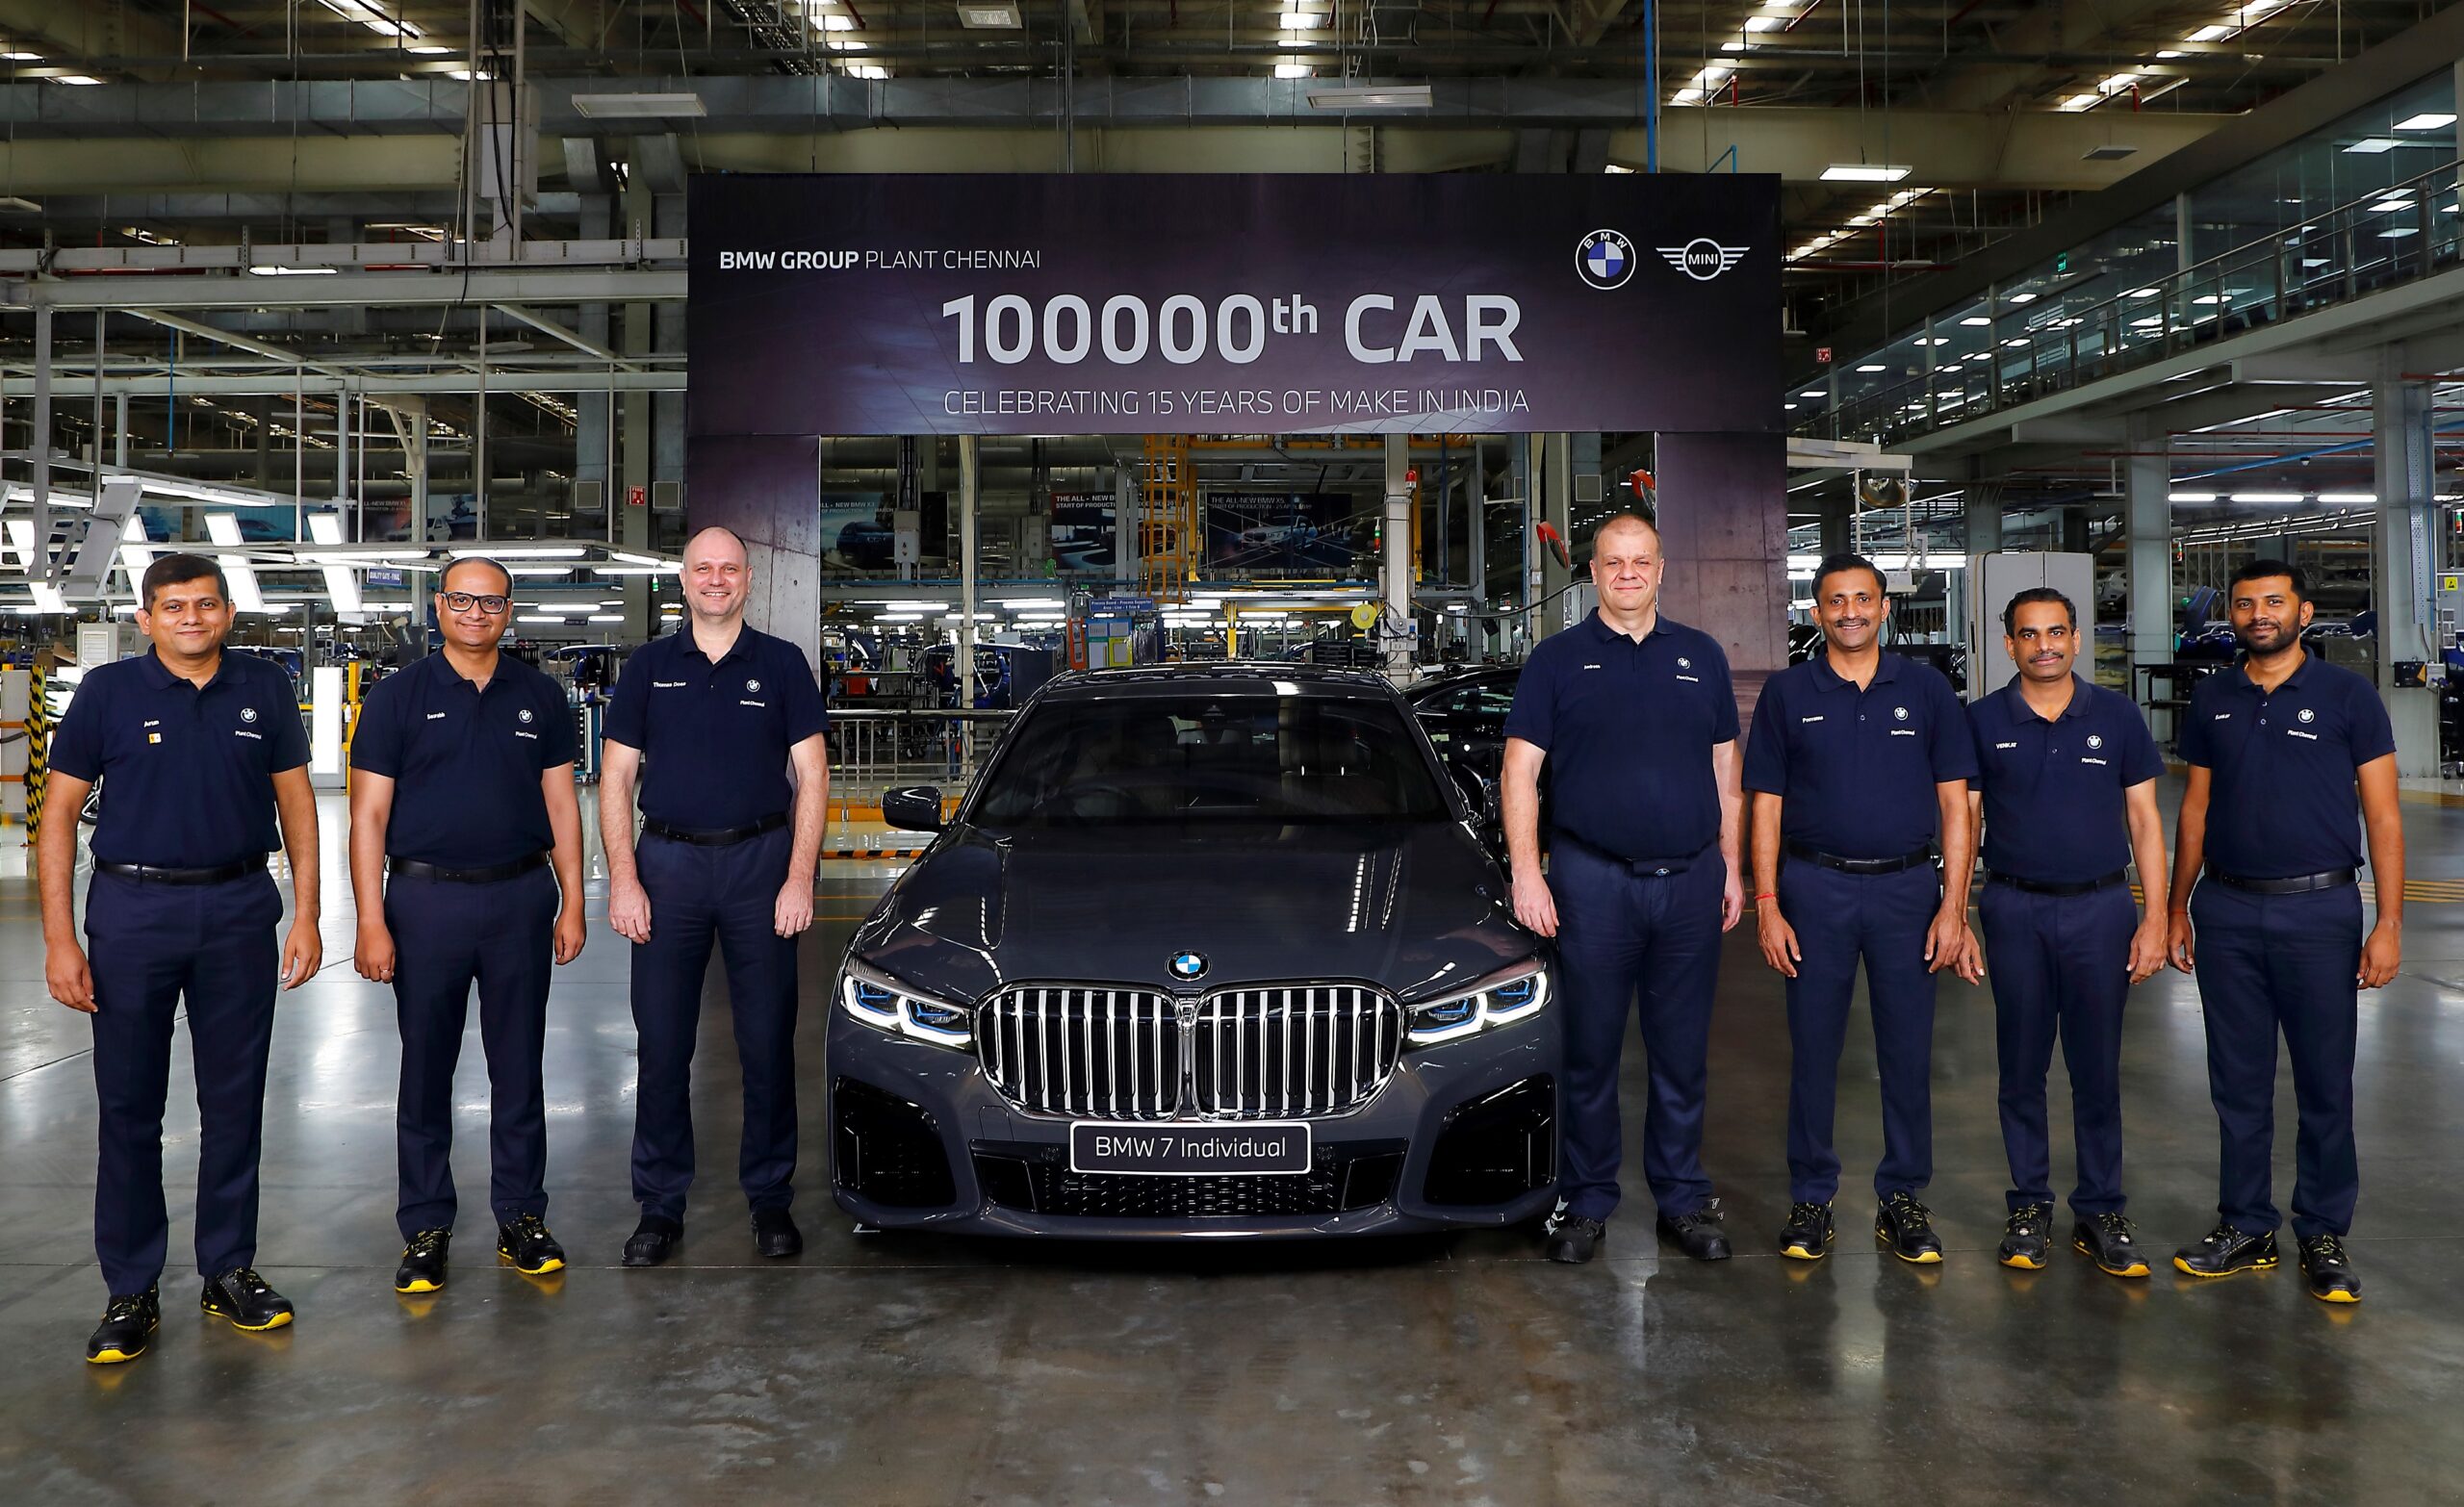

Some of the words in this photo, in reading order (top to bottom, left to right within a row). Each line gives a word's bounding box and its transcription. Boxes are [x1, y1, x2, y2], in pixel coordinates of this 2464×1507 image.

[1583, 232, 1629, 250] BMW
[720, 251, 776, 269] BMW
[781, 250, 860, 269] GROUP
[865, 250, 938, 269] PLANT
[943, 249, 1041, 269] CHENNAI
[1687, 253, 1719, 266] MINI
[942, 294, 1319, 365] 100000th
[1345, 294, 1525, 365] CAR
[943, 390, 1140, 415] CELEBRATING
[1147, 390, 1174, 415] 15
[1180, 390, 1273, 415] YEARS
[1282, 390, 1322, 415] OF
[1330, 390, 1410, 414] MAKE
[1418, 389, 1445, 414] IN
[1454, 389, 1530, 414] INDIA
[1995, 741, 2017, 750] VENKAT
[1095, 1136, 1155, 1158] BMW
[1160, 1137, 1174, 1158] 7
[1181, 1137, 1286, 1159] Individual
